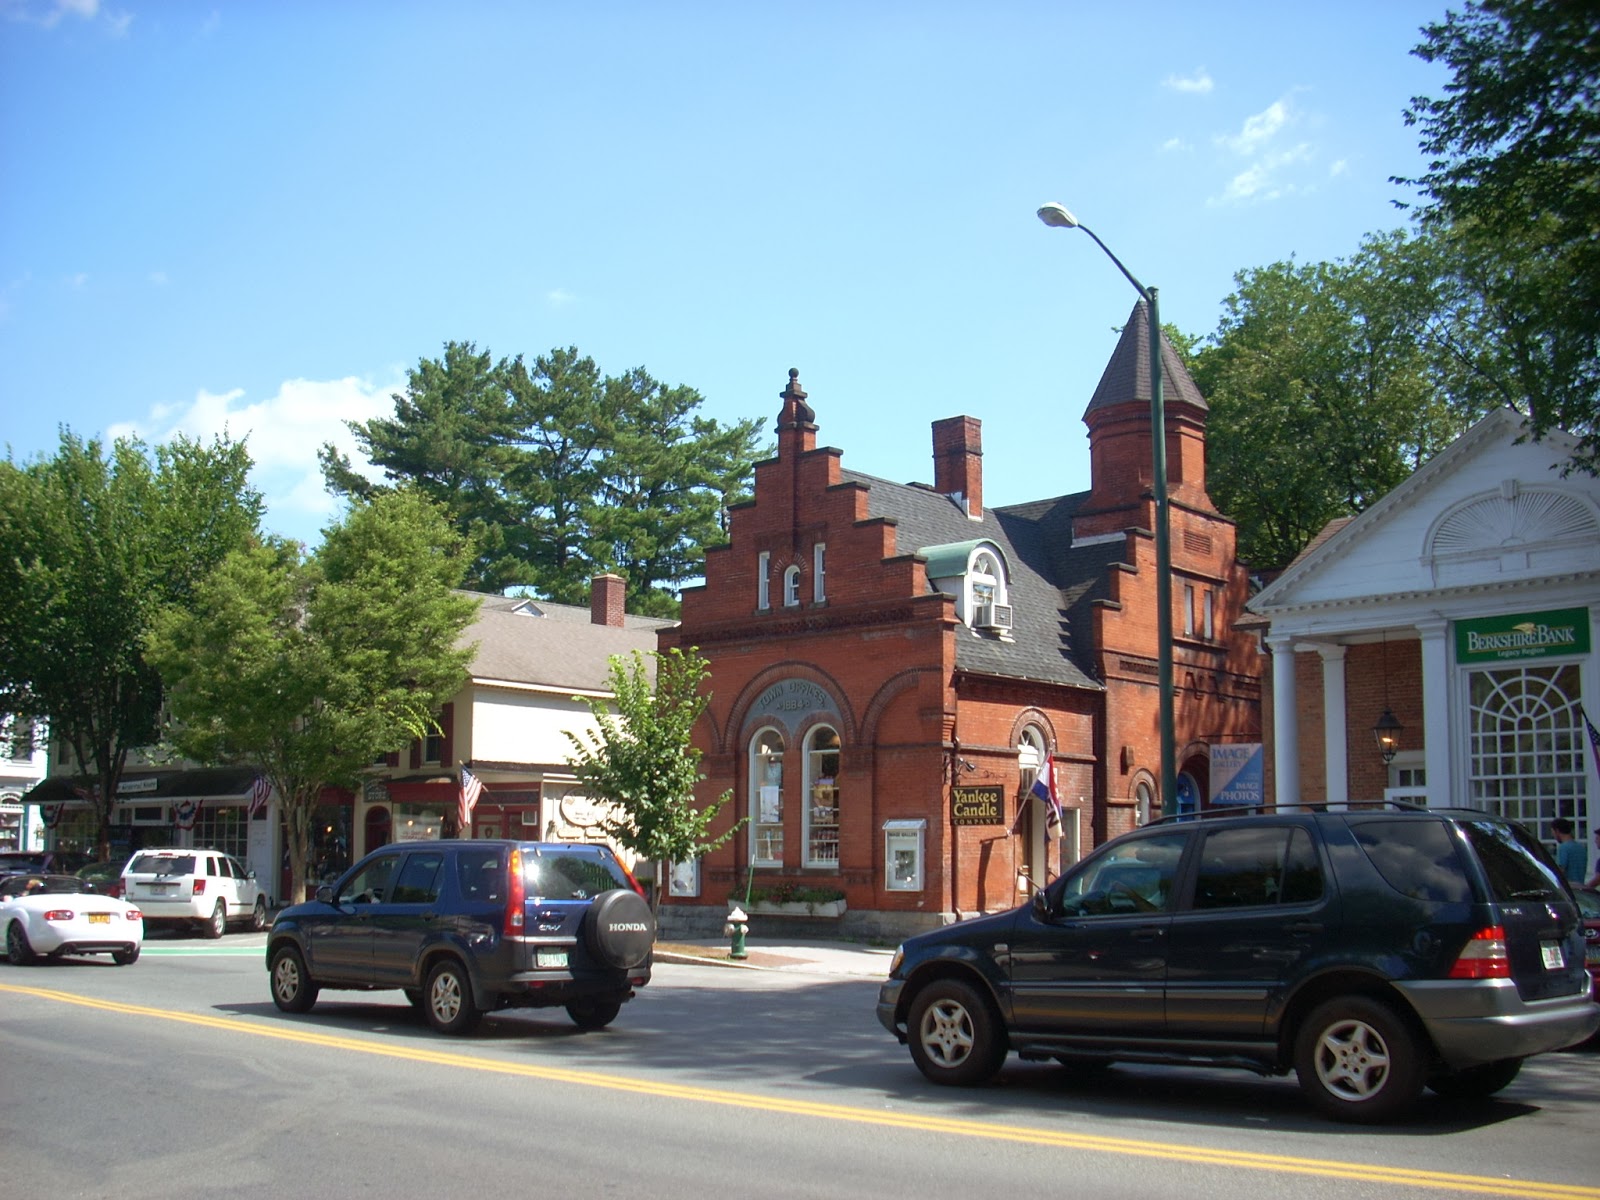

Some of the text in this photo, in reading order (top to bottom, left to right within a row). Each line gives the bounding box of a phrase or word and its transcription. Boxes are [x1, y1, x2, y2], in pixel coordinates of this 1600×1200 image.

[1497, 647, 1545, 658] Legacy Region
[757, 684, 784, 710] TOWN
[1212, 748, 1250, 759] IMAGE
[1235, 782, 1259, 790] IMAGE
[953, 789, 998, 803] Yankee
[1220, 790, 1260, 801] PHOTOS
[953, 803, 998, 817] Candle
[953, 818, 998, 826] COMPANY
[609, 923, 648, 932] HONDA
